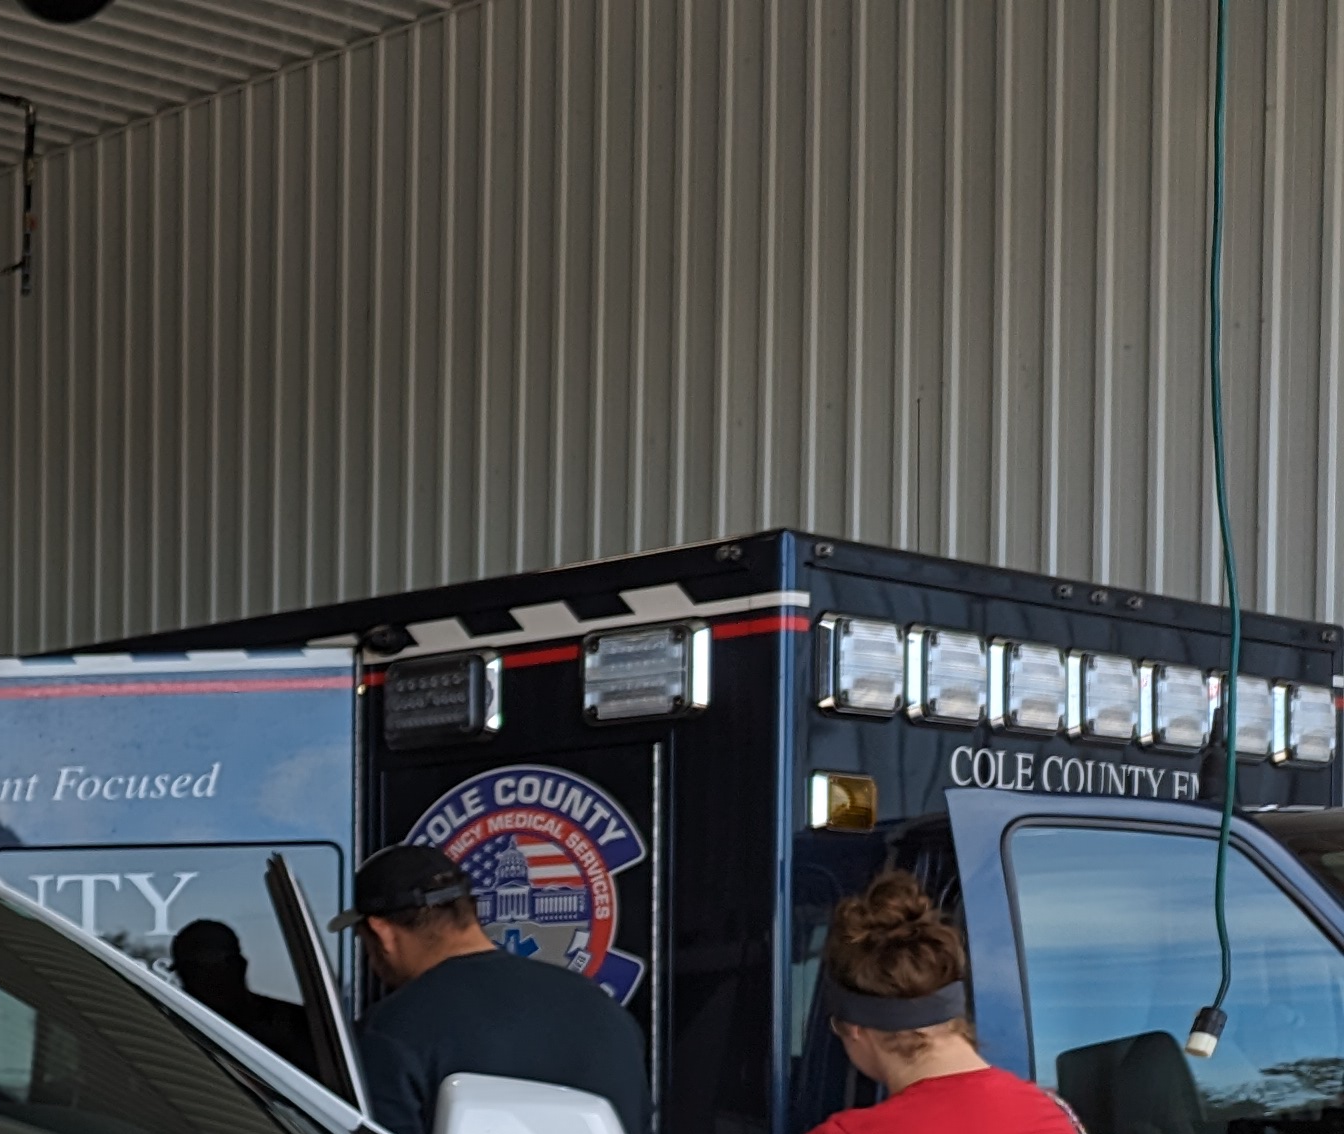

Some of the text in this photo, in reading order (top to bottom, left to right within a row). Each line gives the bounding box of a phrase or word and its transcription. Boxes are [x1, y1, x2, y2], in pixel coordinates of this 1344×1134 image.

[52, 762, 222, 802] Focused
[950, 746, 1035, 791] COLE
[1042, 755, 1167, 798] COUNTY
[494, 776, 627, 846] COUNTY
[488, 813, 562, 838] MEDICAL
[565, 832, 610, 919] SERVICES
